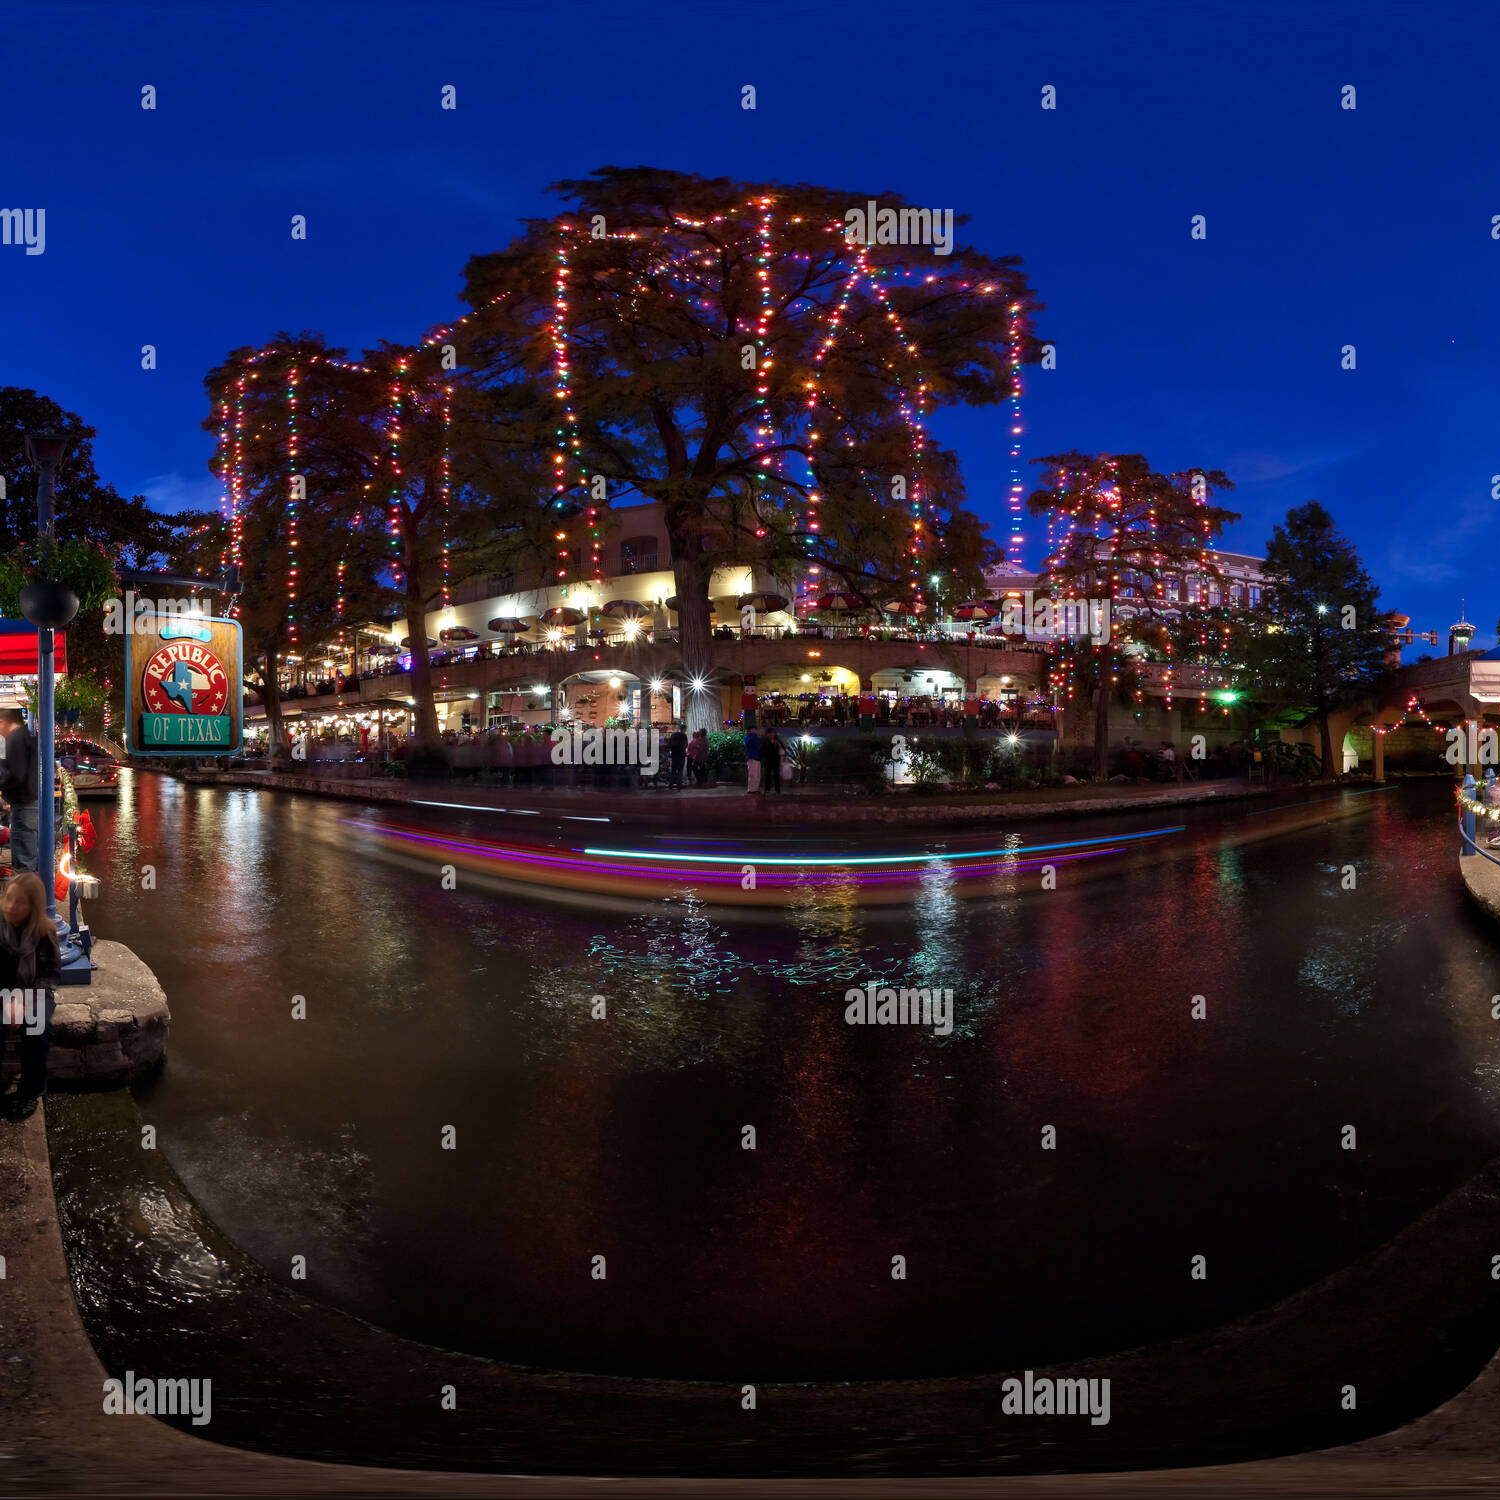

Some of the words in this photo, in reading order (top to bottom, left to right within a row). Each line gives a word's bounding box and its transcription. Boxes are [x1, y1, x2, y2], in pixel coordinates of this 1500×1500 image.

[147, 645, 225, 684] REPUBLIC
[153, 717, 170, 741] OF
[177, 718, 222, 742] TEXAS
